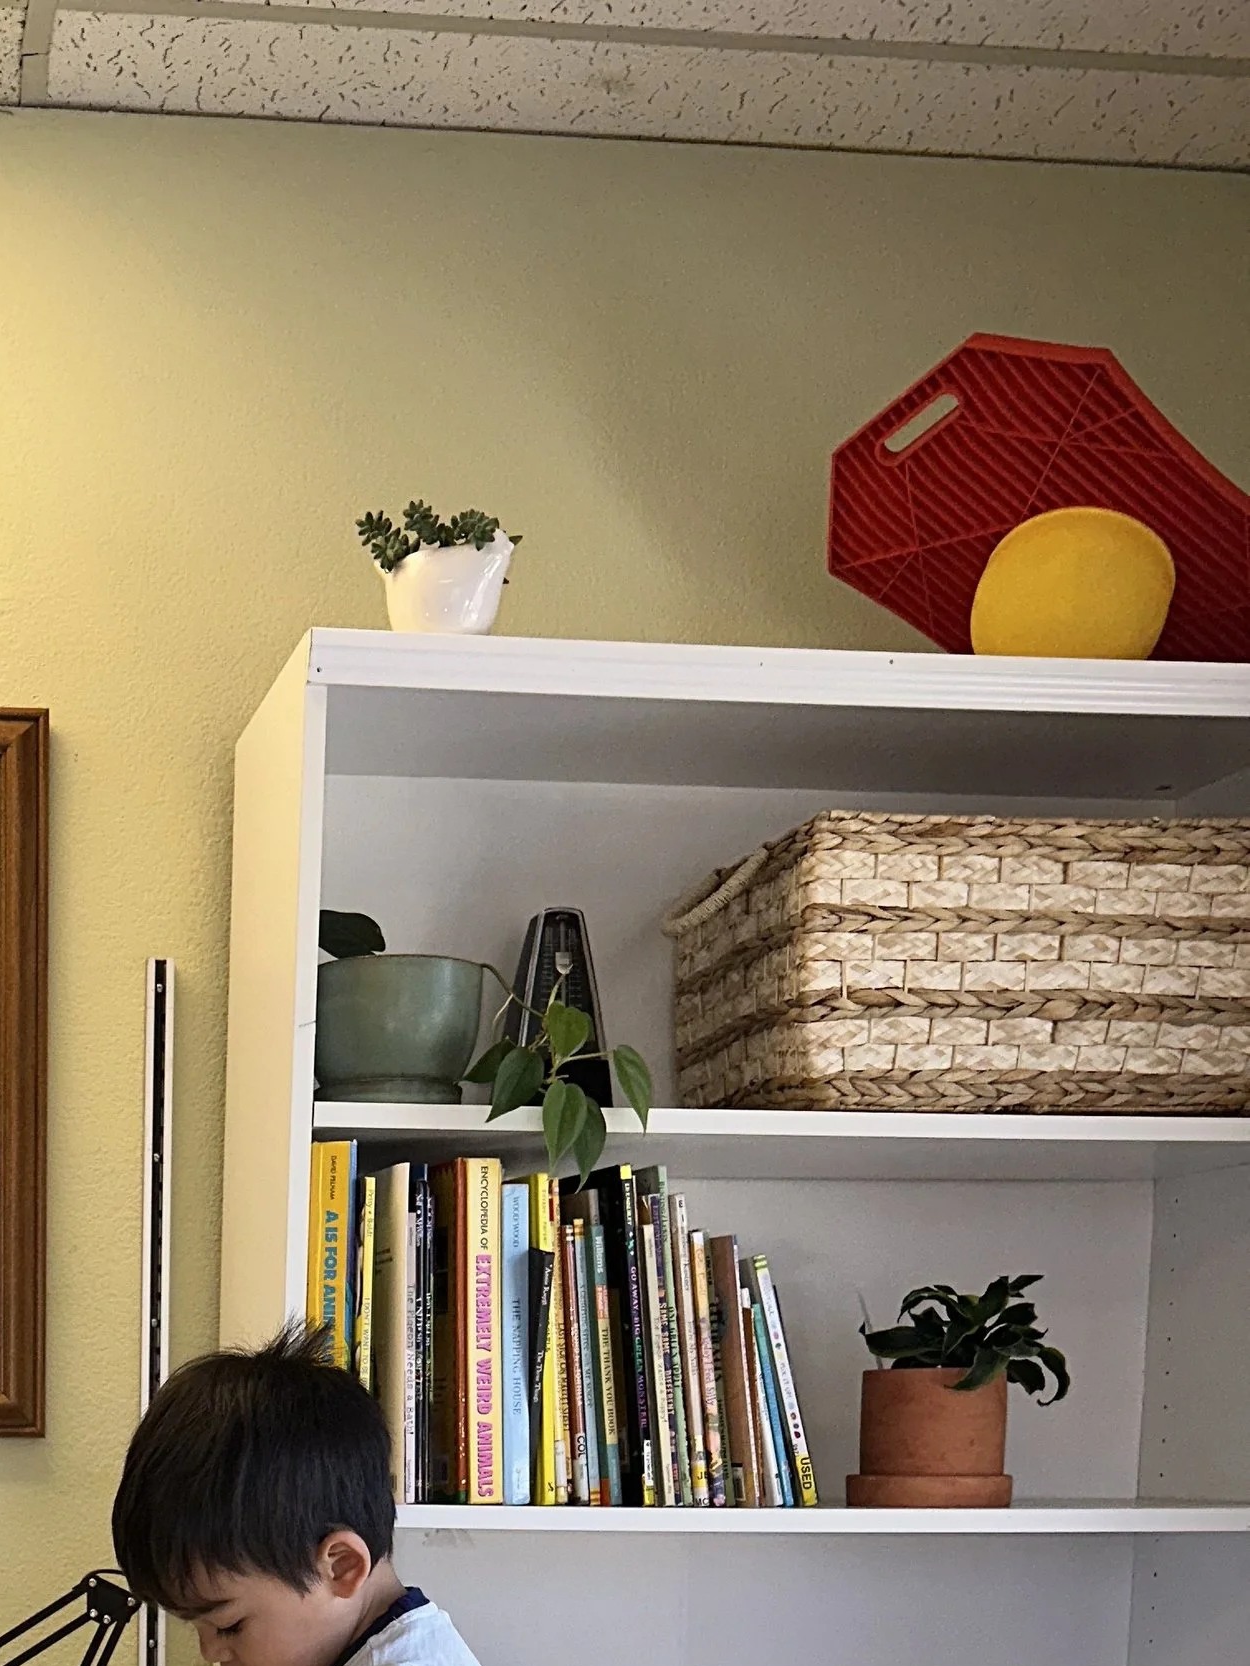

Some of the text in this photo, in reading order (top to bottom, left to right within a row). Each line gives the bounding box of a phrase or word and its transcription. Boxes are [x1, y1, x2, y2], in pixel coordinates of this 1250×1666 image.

[324, 1210, 339, 1224] A
[324, 1227, 338, 1242] IS
[323, 1246, 338, 1281] FOR
[595, 1236, 604, 1273] Willems
[407, 1284, 415, 1304] The
[406, 1310, 415, 1348] Pigeon
[475, 1166, 494, 1497] ENCYCLOPEDIA OF EXTREMELY WEIRD ANIMALS
[630, 1266, 637, 1280] GO
[635, 1336, 643, 1372] GREEN
[512, 1298, 521, 1415] THE NAPPING HOUSE
[661, 1331, 670, 1354] SAME
[406, 1353, 415, 1389] Needs
[603, 1351, 612, 1383] THANK
[705, 1367, 714, 1383] Feel
[605, 1386, 613, 1405] YOU
[664, 1369, 674, 1415] DIFFERENT
[704, 1386, 716, 1406] Silly
[406, 1407, 414, 1435] Bath!
[607, 1408, 616, 1435] BOOK
[576, 1435, 586, 1457] COL
[800, 1457, 812, 1489] USED
